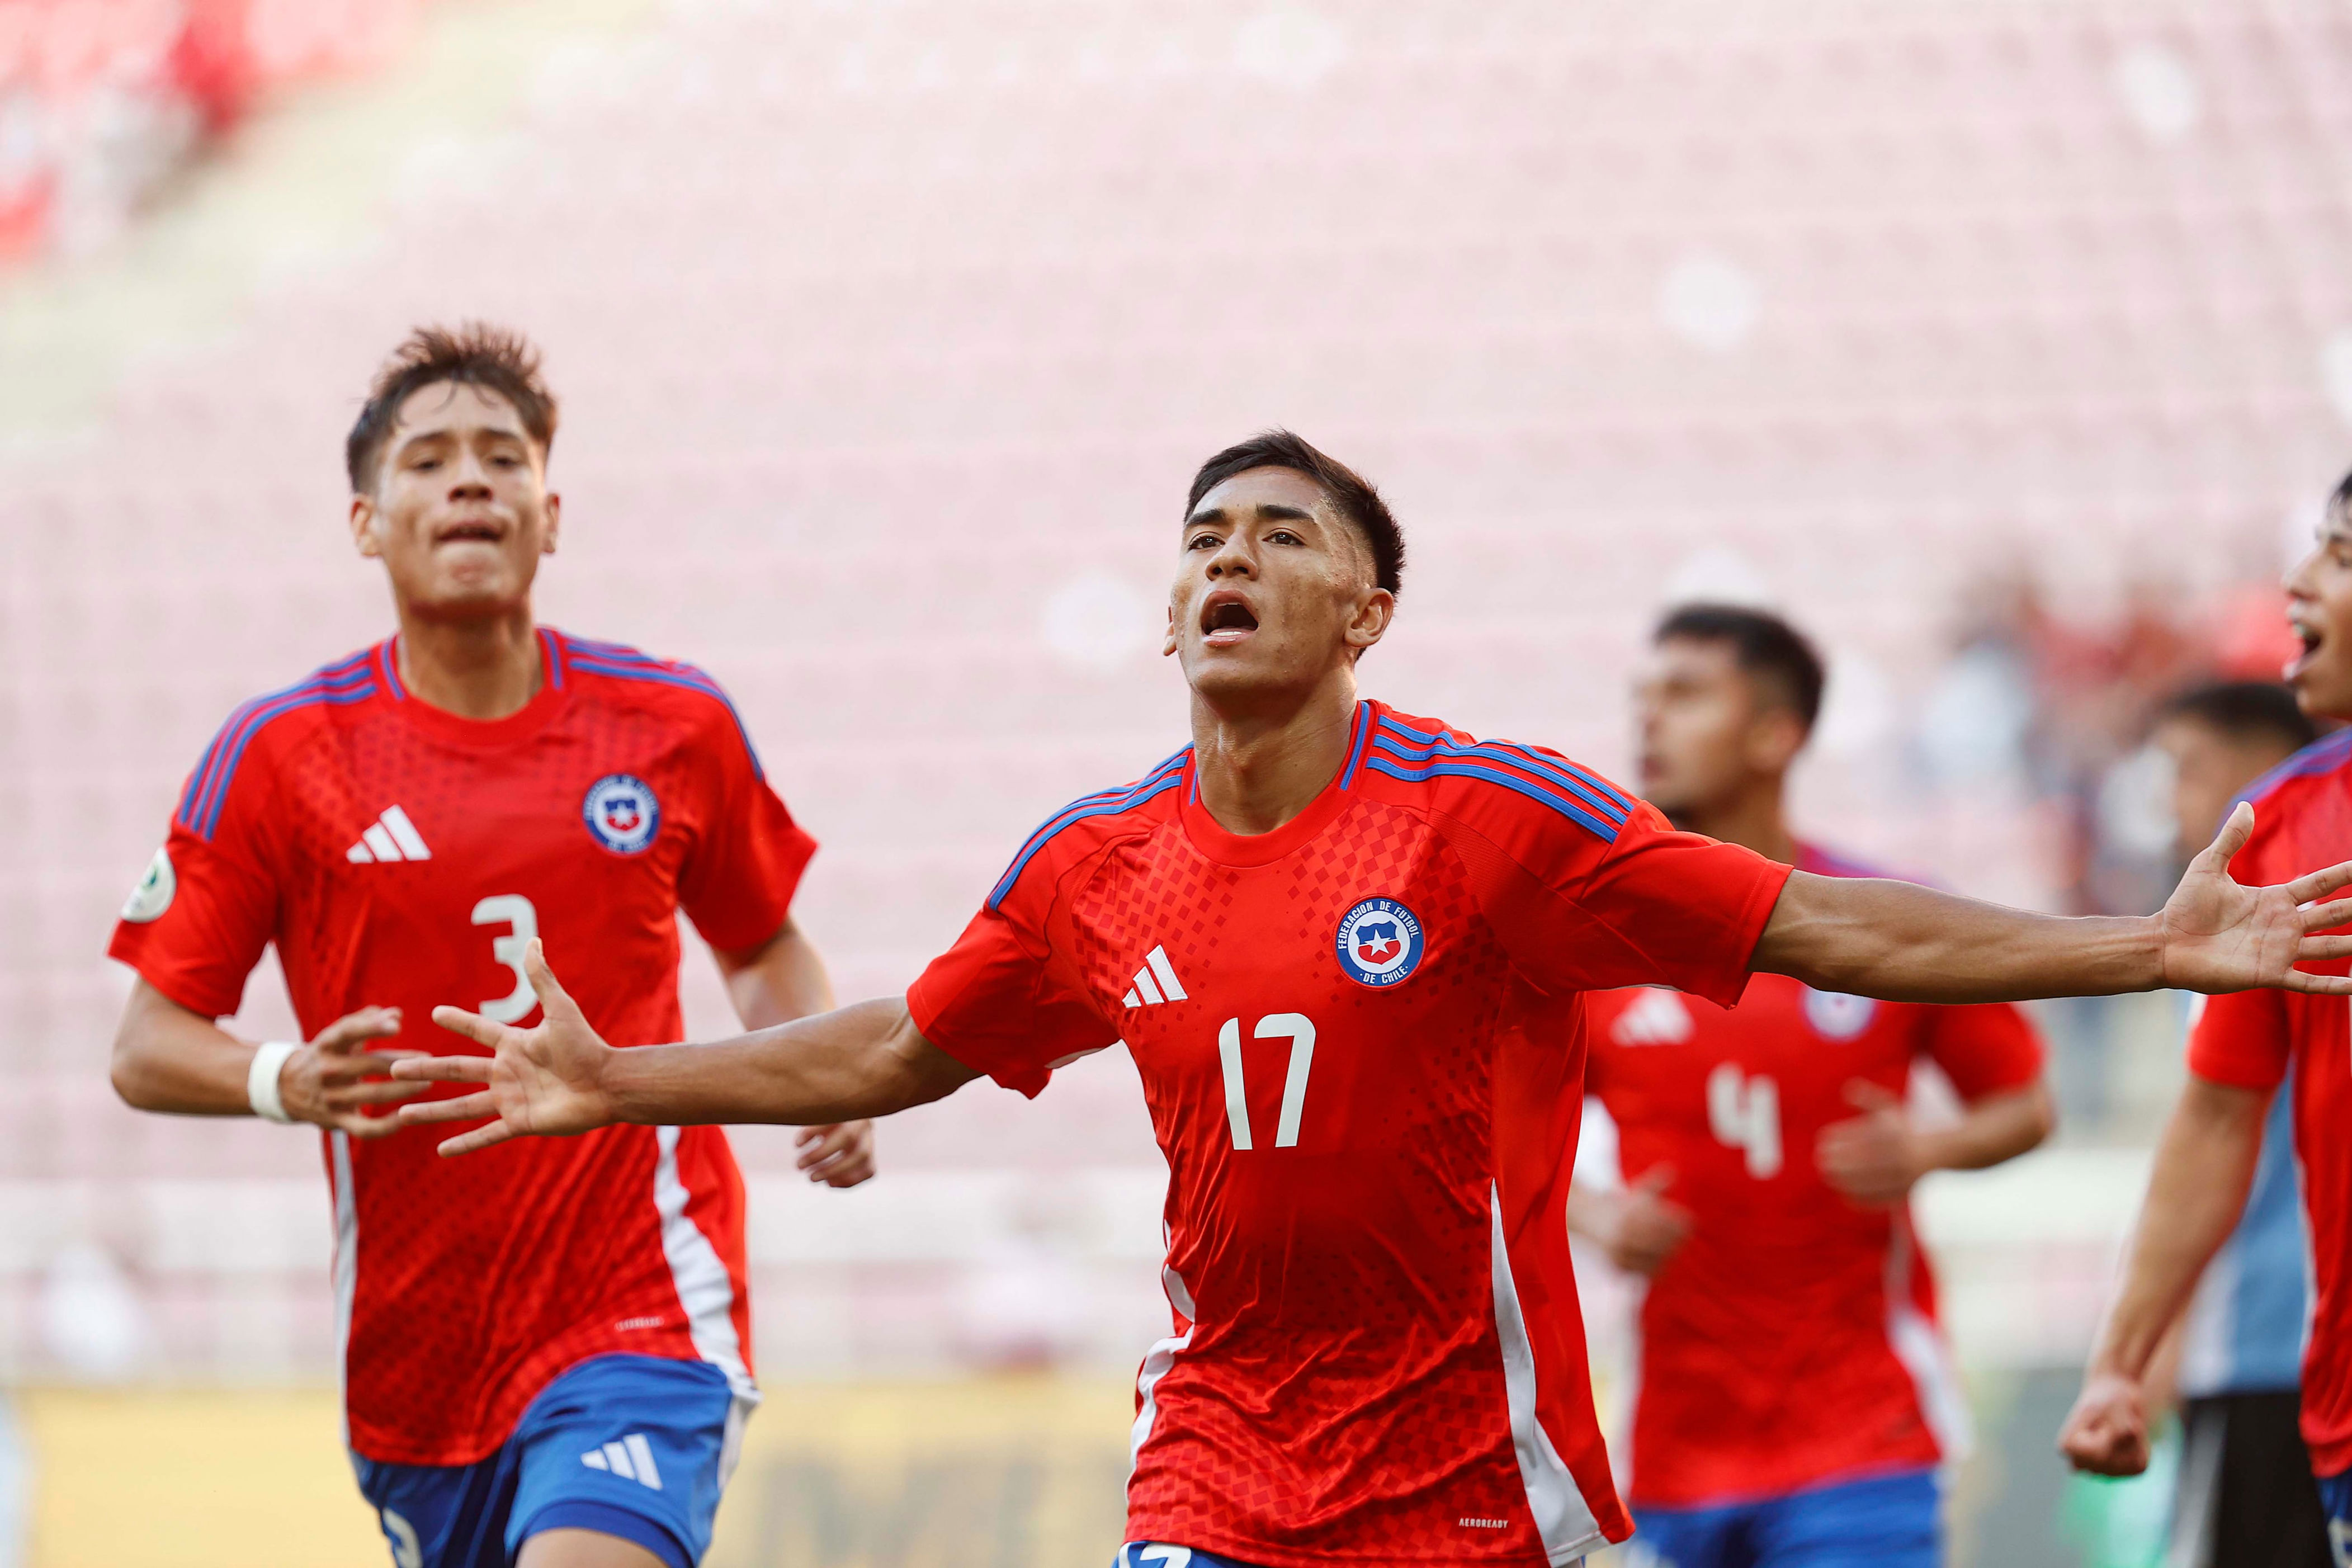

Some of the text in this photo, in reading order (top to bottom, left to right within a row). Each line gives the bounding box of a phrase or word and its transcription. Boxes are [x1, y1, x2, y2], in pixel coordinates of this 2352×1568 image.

[470, 894, 539, 1024] 3
[1338, 901, 1419, 949] FEDERACION DE FUTBOL
[1363, 966, 1408, 984] DE CHILE
[1218, 1013, 1316, 1150] 17
[1707, 1062, 1783, 1178] 4
[1458, 1518, 1509, 1529] AEROREADY
